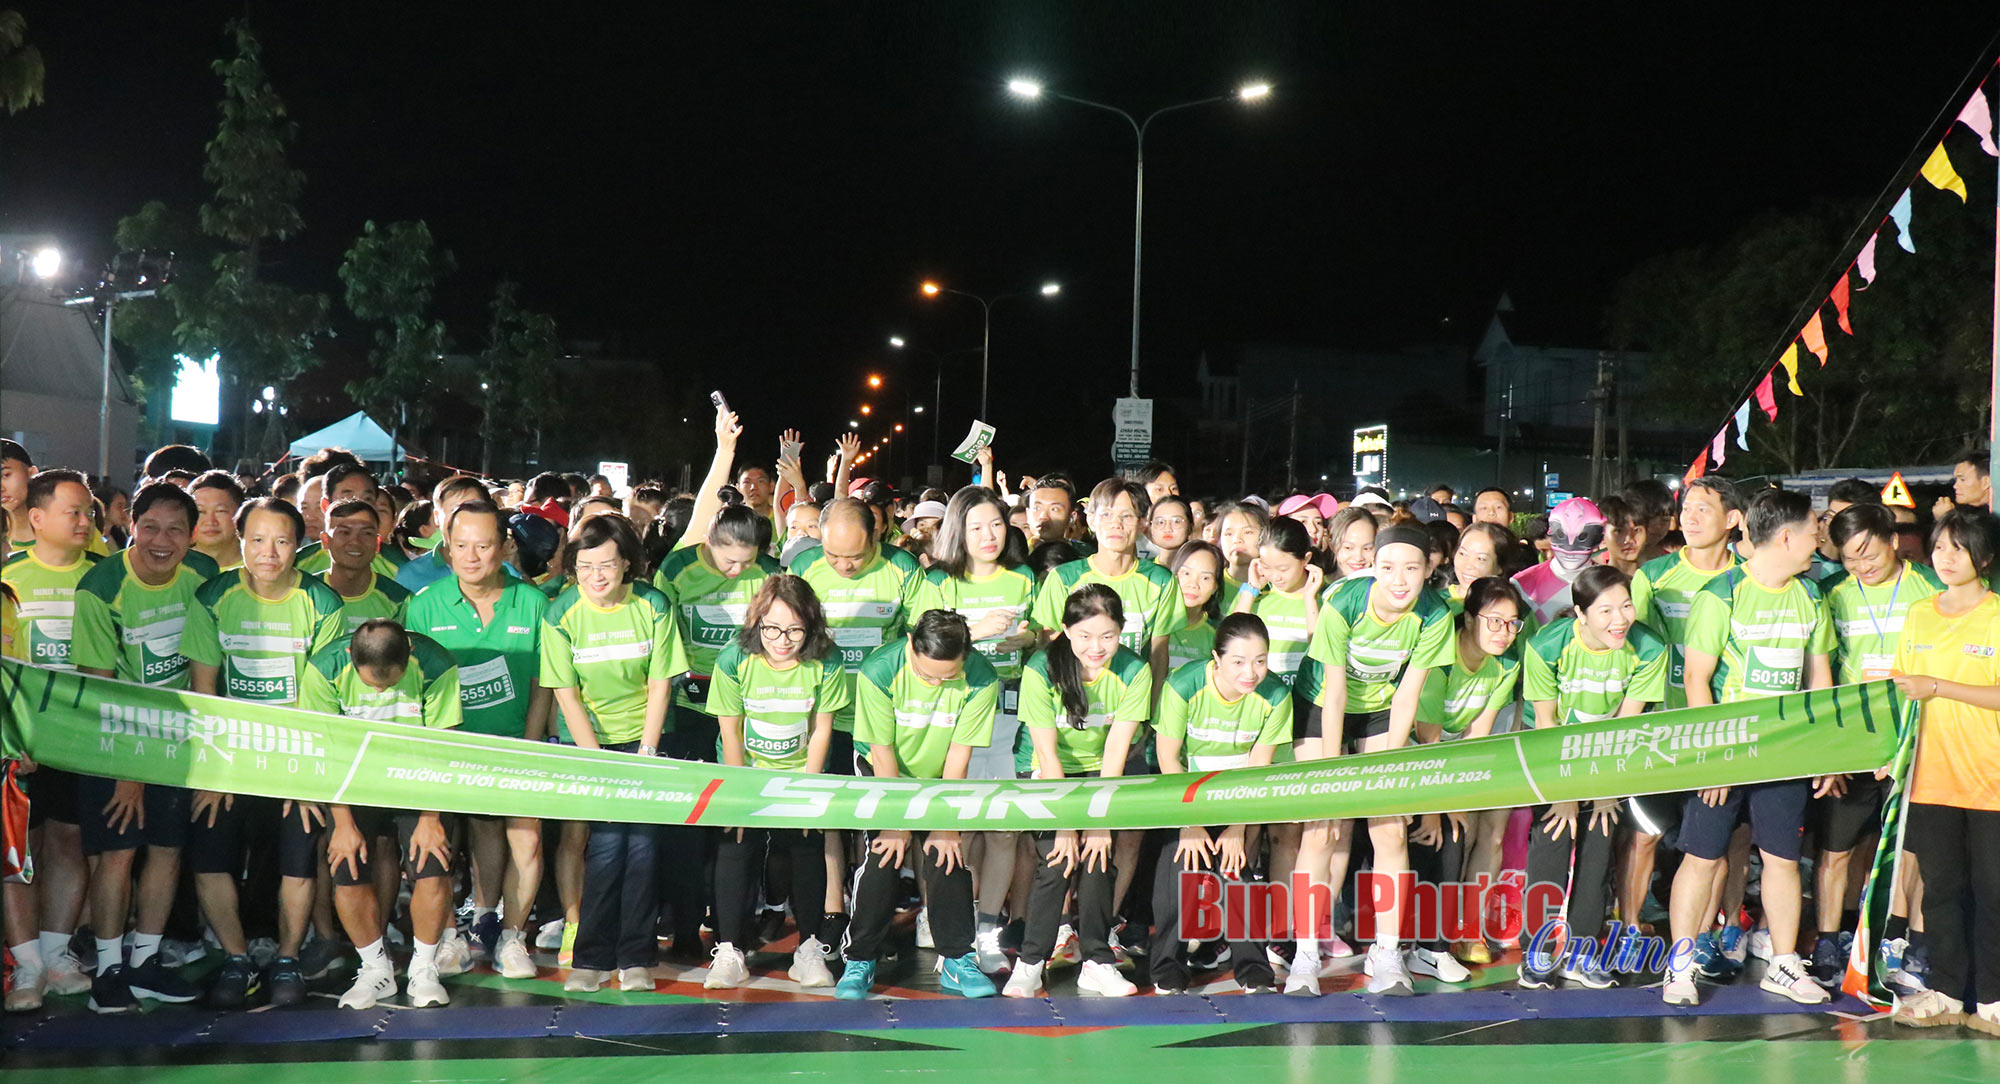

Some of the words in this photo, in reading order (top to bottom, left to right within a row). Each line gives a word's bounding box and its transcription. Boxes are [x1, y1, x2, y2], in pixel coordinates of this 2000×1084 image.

[36, 642, 72, 657] 503
[1962, 643, 1995, 656] BPTV
[230, 677, 285, 693] 555564
[1750, 668, 1796, 686] 50138
[747, 737, 799, 752] 220682
[100, 736, 326, 777] MARATHON
[1560, 745, 1759, 778] MARATHON
[1360, 758, 1448, 776] MARATHON
[385, 766, 453, 784] TRƯỜNG
[456, 772, 495, 788] TƯƠI
[498, 777, 556, 793] GROUP
[654, 790, 694, 803] 2024
[551, 772, 644, 787] MARATHON
[1206, 785, 1269, 801] TRƯỜNG
[1271, 782, 1308, 798] TƯƠI
[1310, 780, 1363, 795] GROUP
[1419, 770, 1456, 787] NĂM
[1456, 769, 1492, 784] 2024
[749, 776, 1158, 820] START
